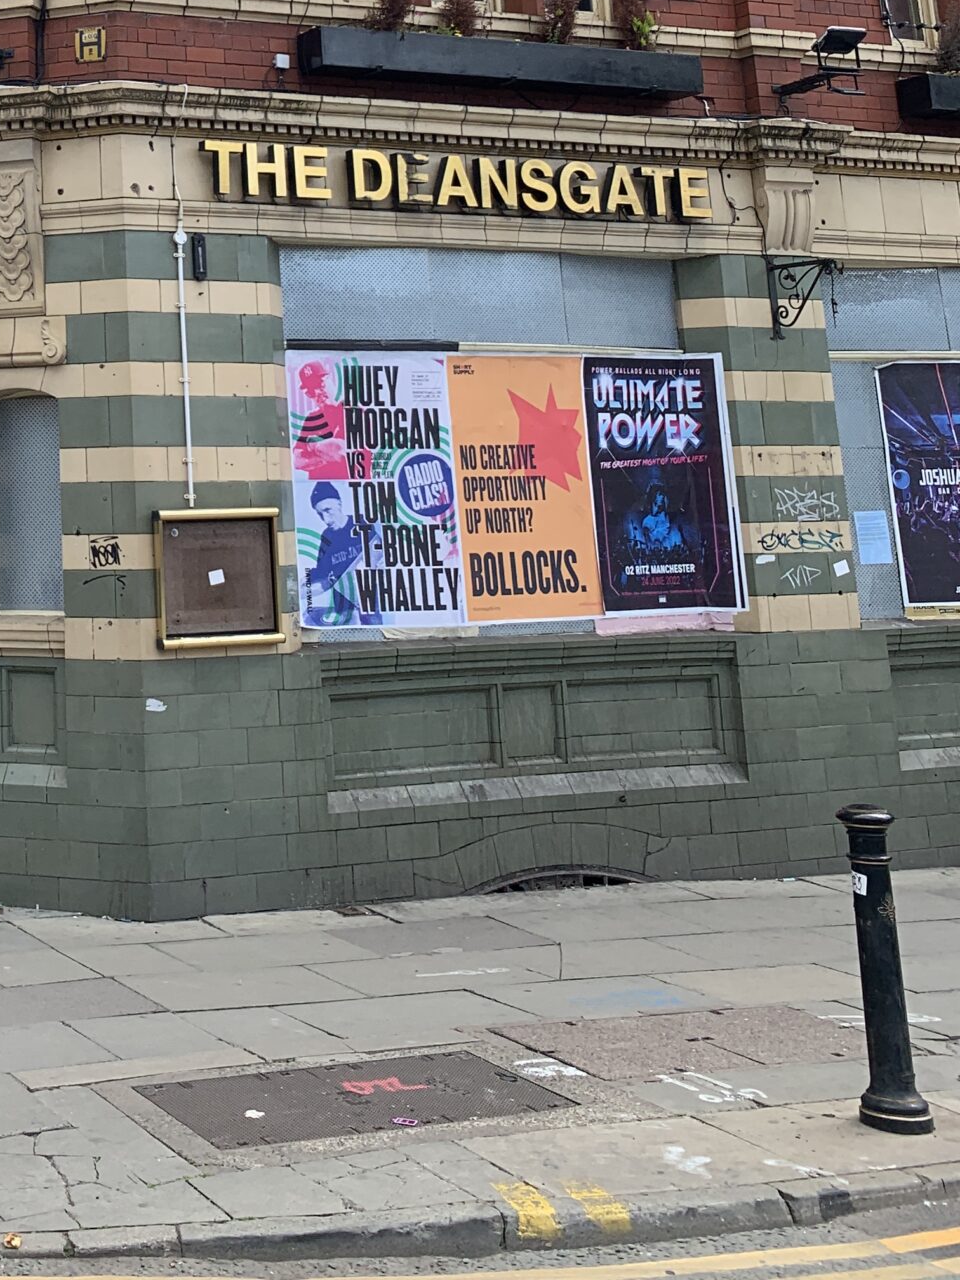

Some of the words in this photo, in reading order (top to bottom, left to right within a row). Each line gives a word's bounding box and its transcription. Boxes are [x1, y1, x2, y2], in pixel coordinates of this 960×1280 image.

[200, 139, 332, 199] THE
[346, 148, 714, 219] DEANSGATE
[591, 366, 613, 374] POWER
[615, 367, 642, 375] BALLADS
[644, 367, 656, 375] ALL
[658, 368, 676, 376] NIGHT
[678, 368, 701, 376] LONG
[343, 365, 399, 407] HUEY
[592, 377, 703, 412] ULTIMATE
[344, 408, 441, 450] MORGAN
[597, 412, 702, 451] POWER
[346, 452, 366, 479] VS
[460, 444, 477, 471] NO
[480, 444, 537, 471] CREATIVE
[600, 460, 612, 469] THE
[612, 459, 641, 468] GREATEST
[642, 457, 661, 467] NIGHT
[661, 457, 669, 466] OF
[670, 456, 686, 465] YOUR
[404, 460, 444, 488] RADIO
[463, 475, 547, 502] OPPORTUNITY
[349, 481, 399, 524] TOM
[408, 482, 451, 511] CLASH
[465, 508, 482, 535] UP
[486, 506, 533, 534] NORTH?
[469, 549, 587, 597] BOLLOCKS.
[635, 565, 650, 575] RITZ
[651, 563, 696, 574] MANCHESTER
[650, 576, 664, 586] JUNE
[665, 575, 681, 585] 2022
[355, 567, 459, 613] WHALLEY
